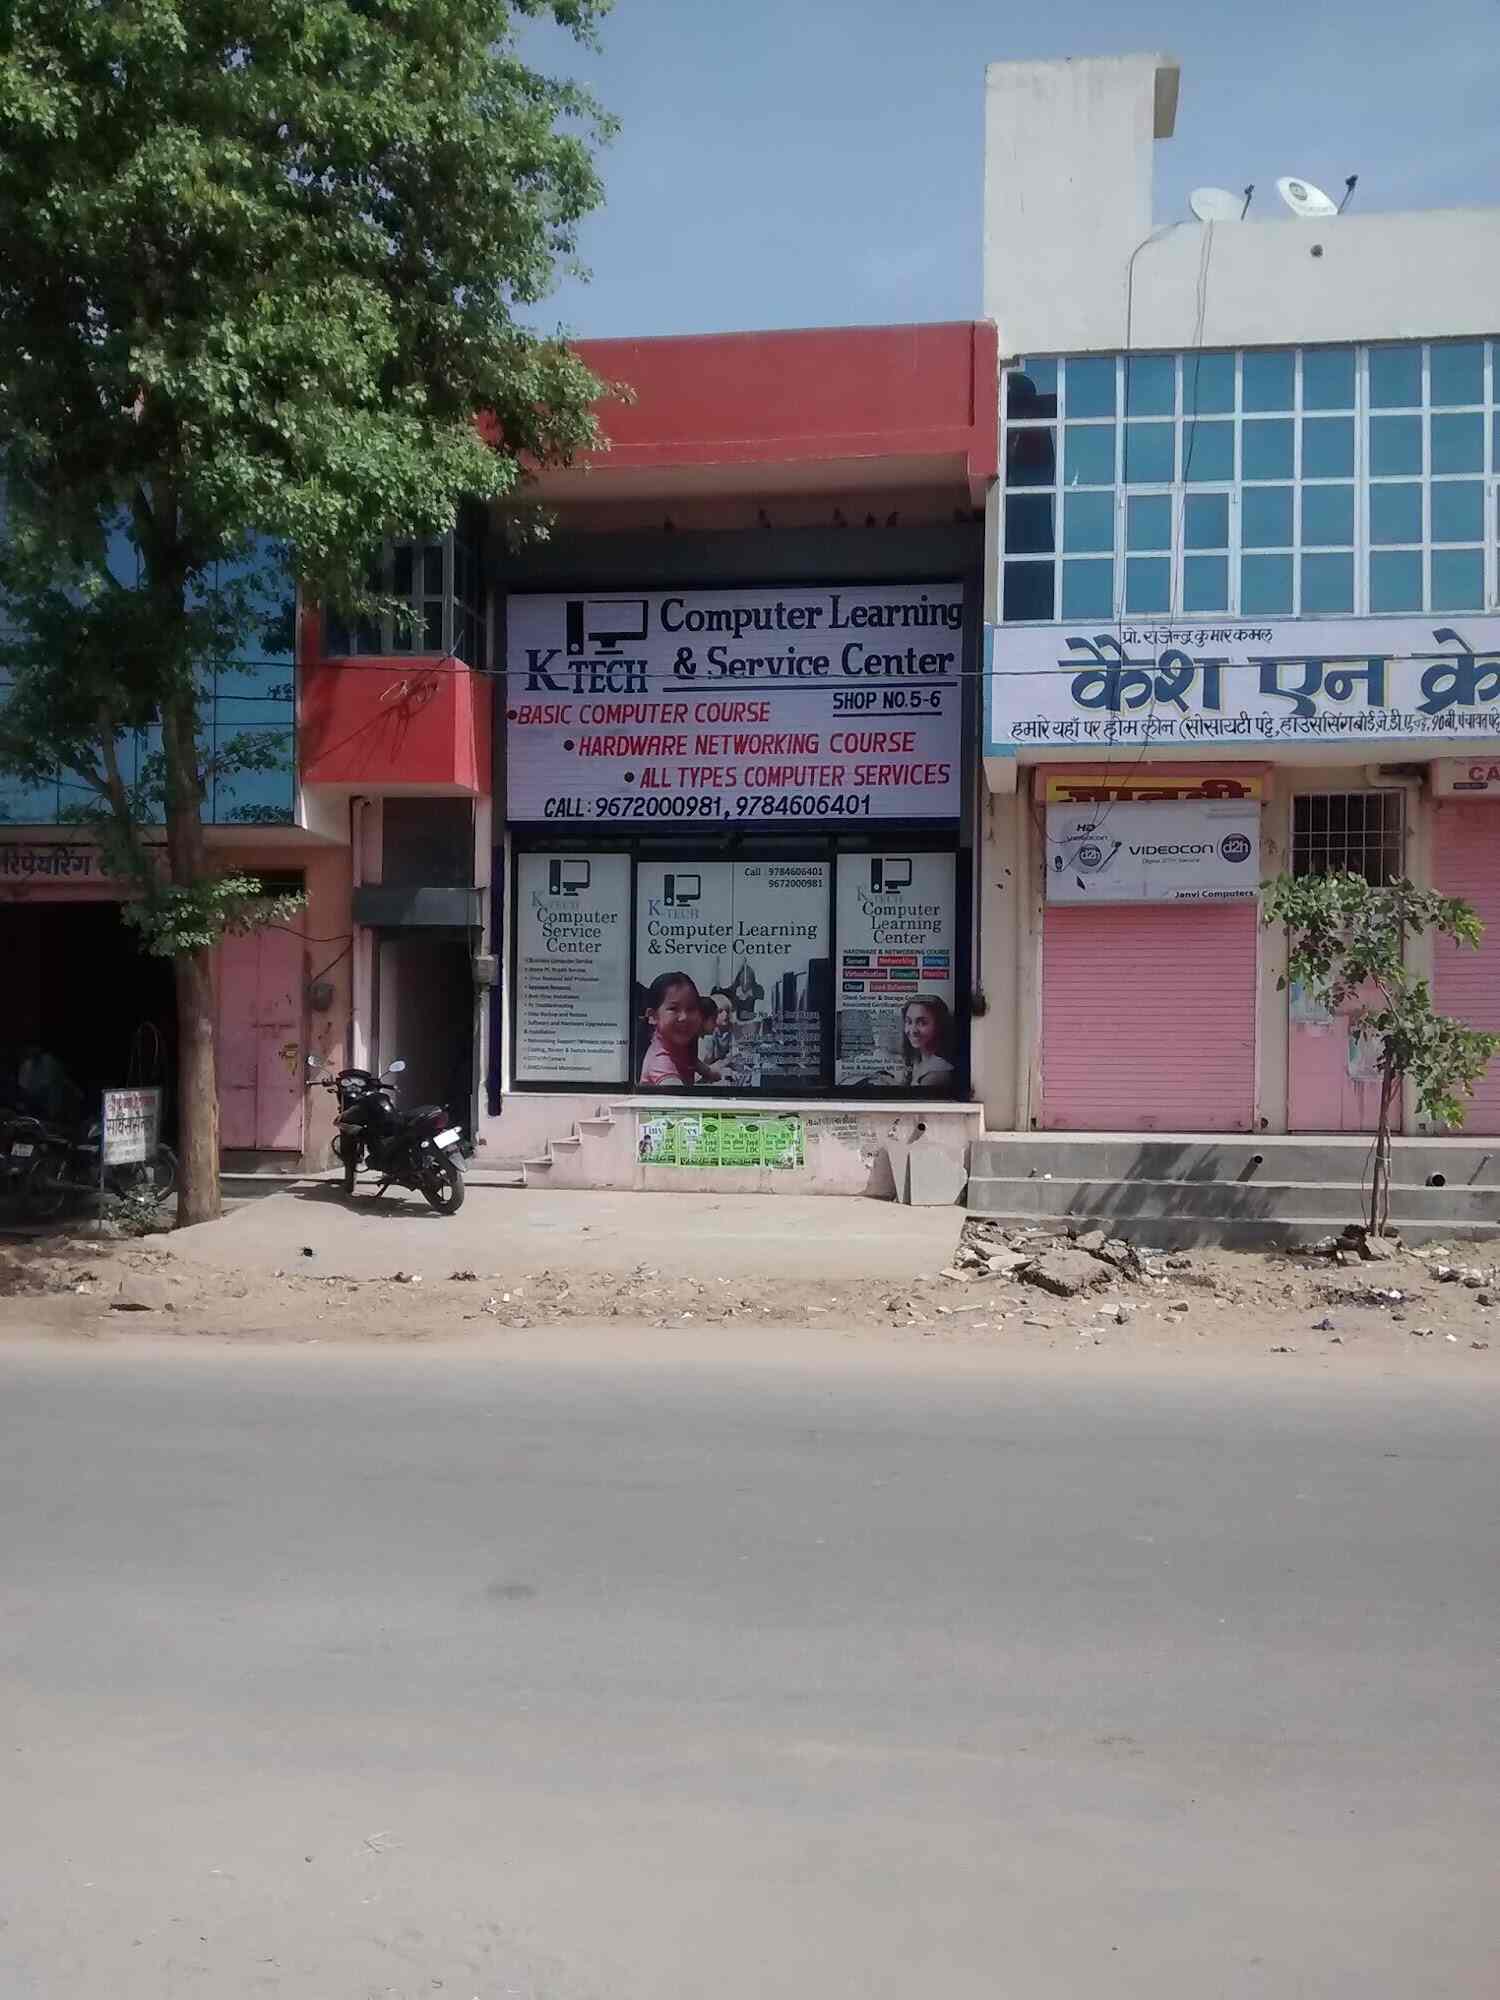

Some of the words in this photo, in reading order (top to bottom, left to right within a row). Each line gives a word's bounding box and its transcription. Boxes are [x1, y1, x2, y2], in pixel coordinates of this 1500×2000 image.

[661, 598, 823, 639] Computer
[829, 594, 962, 630] Learning
[673, 646, 697, 680] &
[707, 646, 830, 679] Service
[841, 643, 955, 676] Center
[1247, 652, 1394, 716] एन
[833, 692, 877, 710] SHOP
[518, 704, 572, 725] BASIC
[579, 703, 688, 724] COMPUTER
[694, 701, 771, 723] COURSE
[1011, 714, 1050, 741] हमारे
[1084, 719, 1101, 740] पर
[578, 735, 688, 756] HARDWARE
[694, 733, 819, 756] NETWORKING
[830, 732, 916, 753] COURSE
[640, 767, 672, 789] ALL
[678, 767, 737, 788] TYPES
[744, 765, 845, 788] COMPUTER
[854, 764, 951, 787] SERVICES
[735, 794, 871, 817] 9784606401
[1128, 843, 1214, 856] VIDEOCON
[1175, 889, 1200, 900] Janvi
[1201, 888, 1254, 900] Computers
[536, 906, 618, 926] Computer
[862, 901, 941, 919] Computer
[542, 922, 602, 938] Service
[647, 919, 733, 939] Computer
[738, 920, 818, 940] Learning
[871, 916, 942, 934] Learning
[546, 937, 603, 953] Center
[647, 939, 662, 955] &
[664, 938, 727, 955] Service
[732, 938, 793, 955] Center
[873, 930, 927, 945] Center
